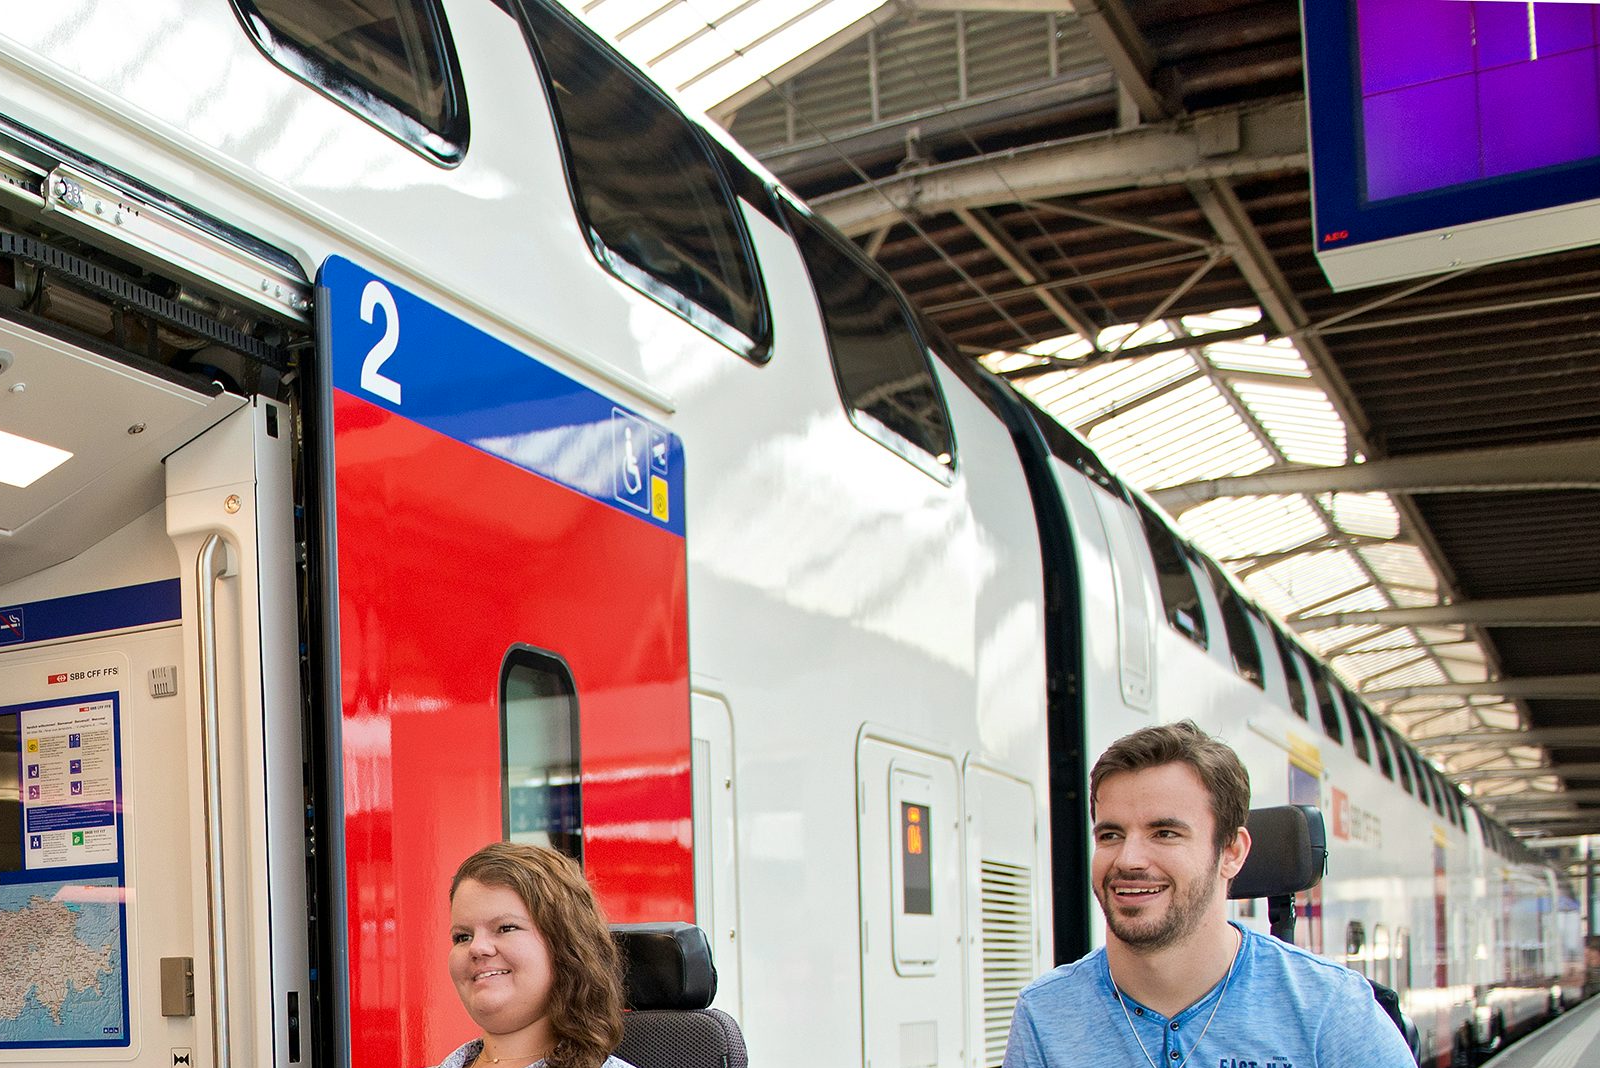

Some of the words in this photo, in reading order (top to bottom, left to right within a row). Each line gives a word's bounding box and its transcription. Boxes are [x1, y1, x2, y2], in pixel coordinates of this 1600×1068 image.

[360, 280, 401, 405] 2
[69, 672, 85, 681] SBB
[86, 669, 101, 679] CFF
[103, 667, 118, 676] FFS
